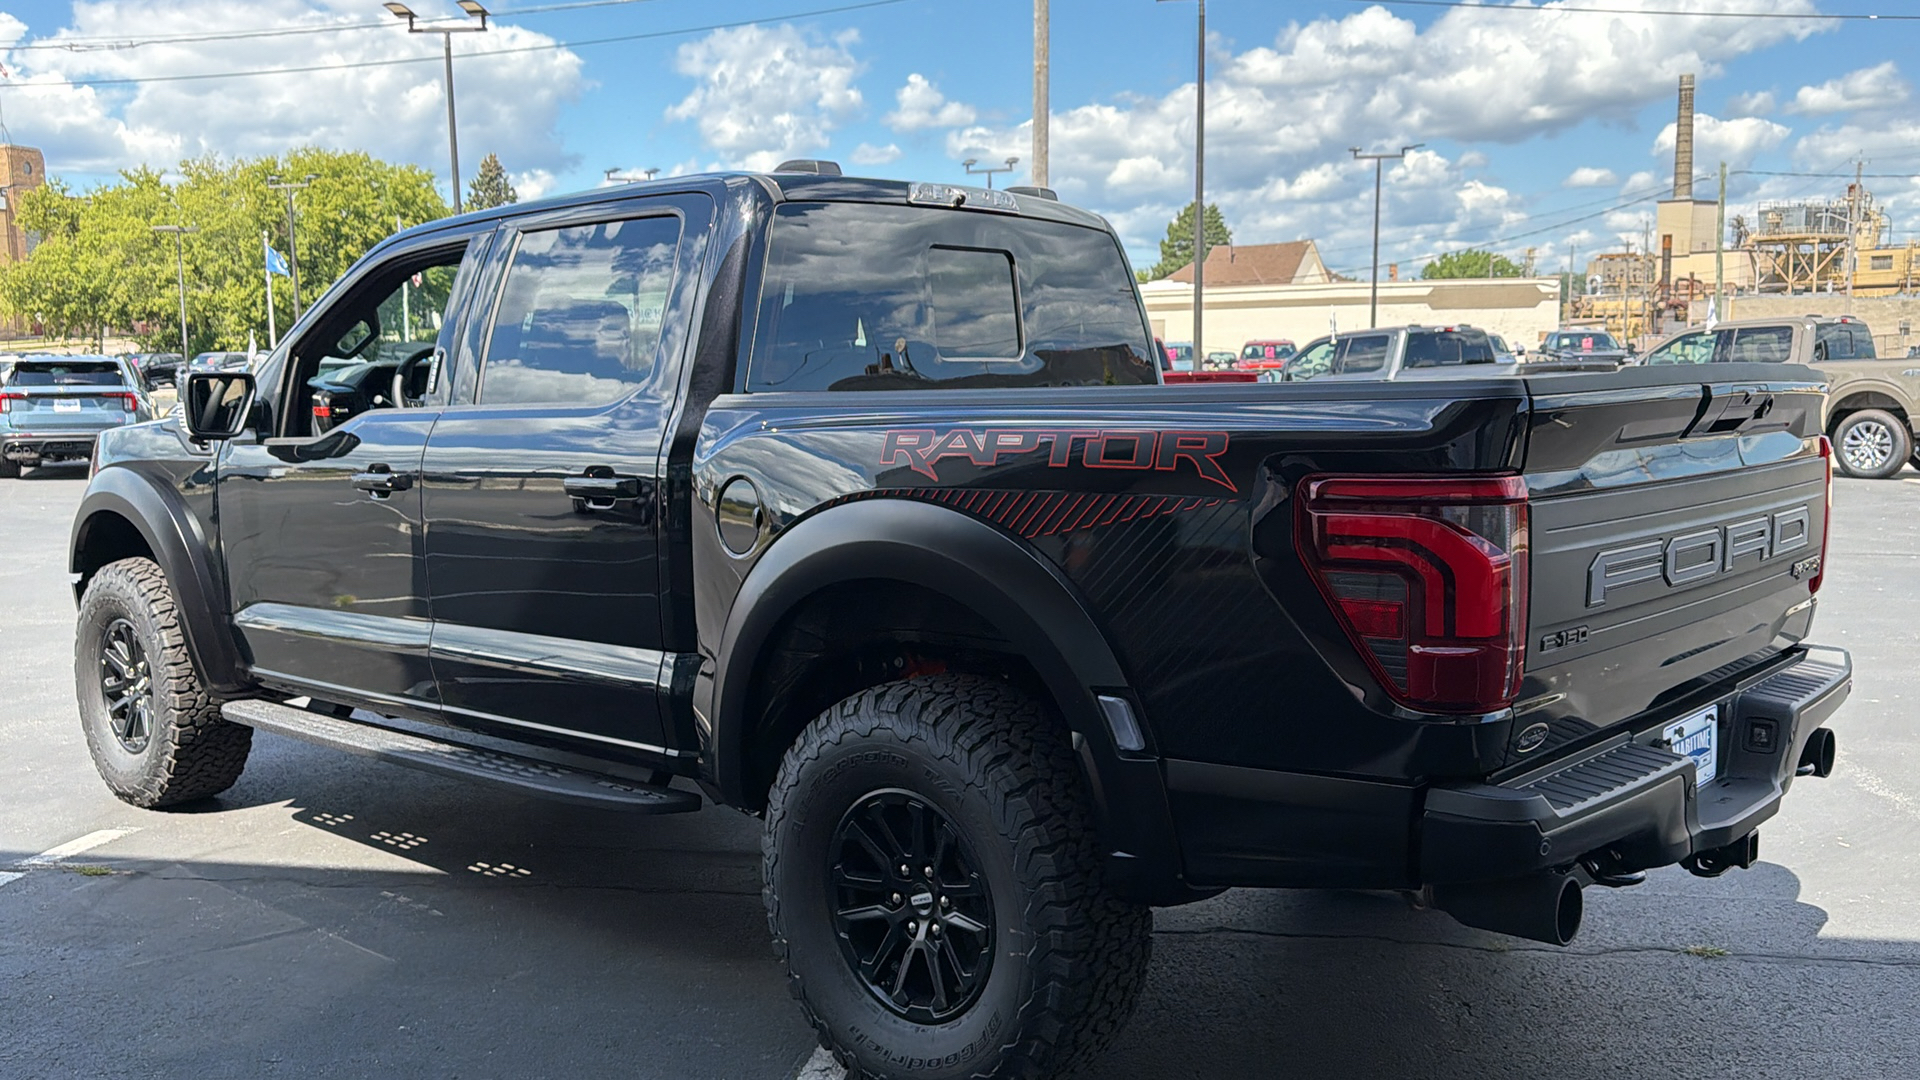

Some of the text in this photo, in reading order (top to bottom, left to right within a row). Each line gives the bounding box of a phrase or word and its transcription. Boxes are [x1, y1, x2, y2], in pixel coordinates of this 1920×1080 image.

[879, 429, 1239, 493] RAPTOR
[1587, 505, 1811, 608] FORD
[1540, 625, 1588, 652] F-150
[1672, 728, 1711, 756] MARITIME
